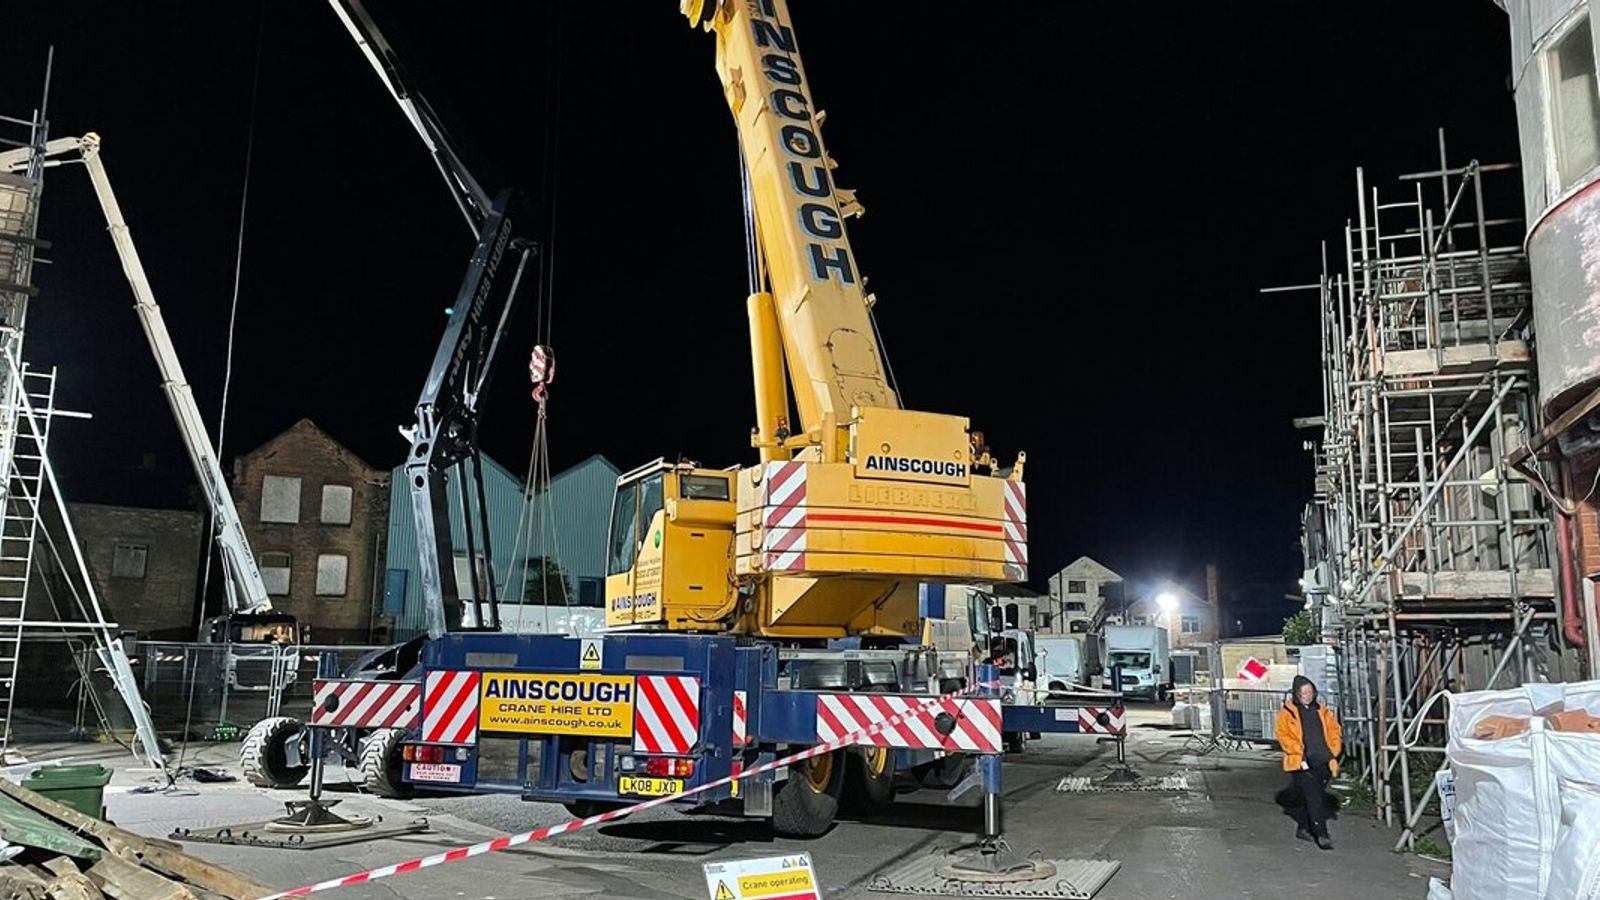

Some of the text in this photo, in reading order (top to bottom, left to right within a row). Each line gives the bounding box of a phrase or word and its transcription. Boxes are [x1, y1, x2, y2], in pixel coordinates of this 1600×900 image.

[487, 218, 512, 278] HYBRID
[866, 455, 966, 478] AINSCOUGH
[485, 678, 630, 703] AINSCOUGH
[499, 703, 612, 717] CRANE HIRE LTD
[489, 716, 622, 729] www.ainscough.co.uk
[623, 780, 653, 792] LK08
[742, 876, 809, 890] Crane operating
